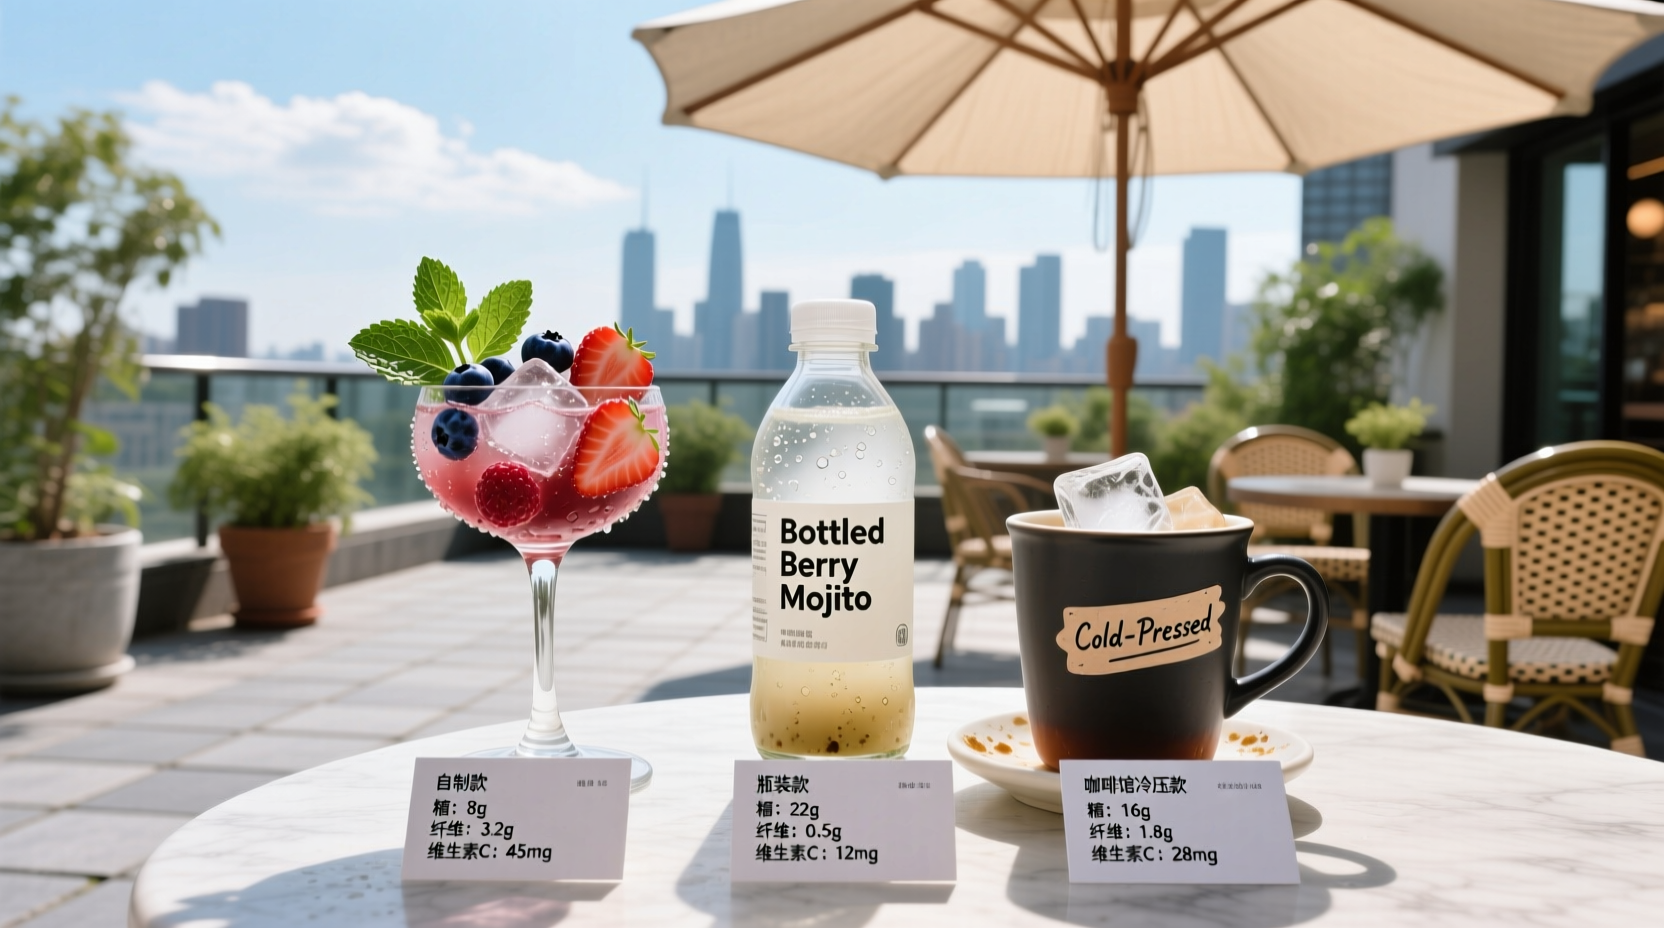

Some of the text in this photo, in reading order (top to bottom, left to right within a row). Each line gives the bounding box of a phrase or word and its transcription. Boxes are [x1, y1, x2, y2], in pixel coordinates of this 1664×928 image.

[780, 516, 885, 546] Bottled
[780, 550, 859, 585] Berry
[780, 583, 872, 619] Mojito
[1075, 603, 1213, 650] Cold-Pressed
[436, 772, 488, 792] 自制款
[1084, 774, 1188, 795] 咖啡馆冷压款
